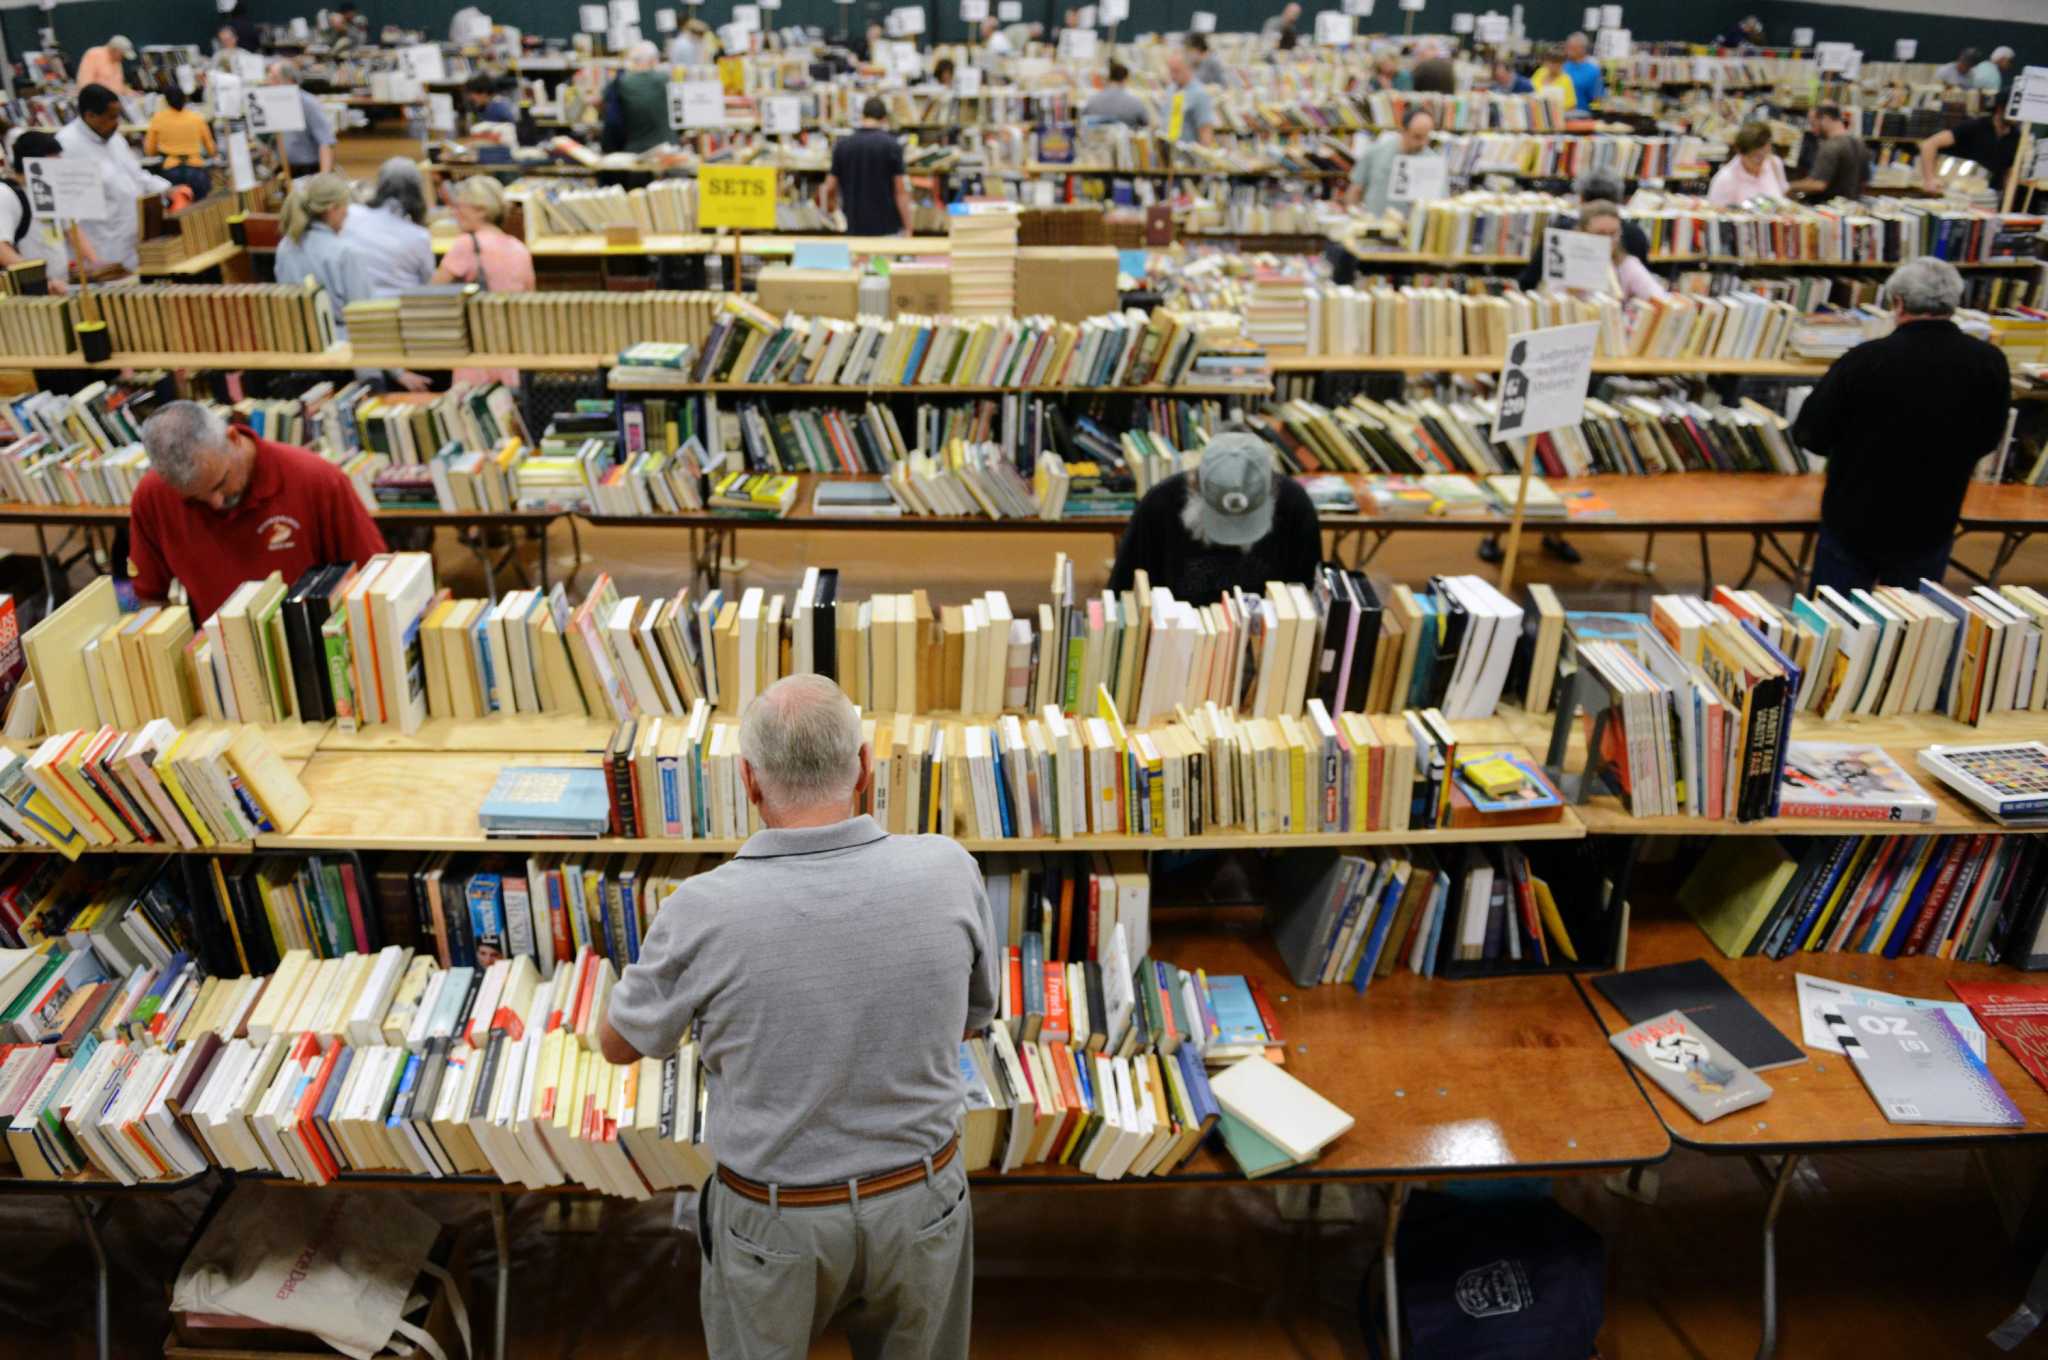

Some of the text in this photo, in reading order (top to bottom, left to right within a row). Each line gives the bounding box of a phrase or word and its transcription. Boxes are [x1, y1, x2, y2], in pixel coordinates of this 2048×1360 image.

[708, 177, 767, 197] SETS
[1753, 708, 1768, 748] VANITY
[1765, 706, 1780, 745] VANITY
[1626, 1016, 1687, 1049] MAUS
[1857, 1015, 1919, 1036] OZ
